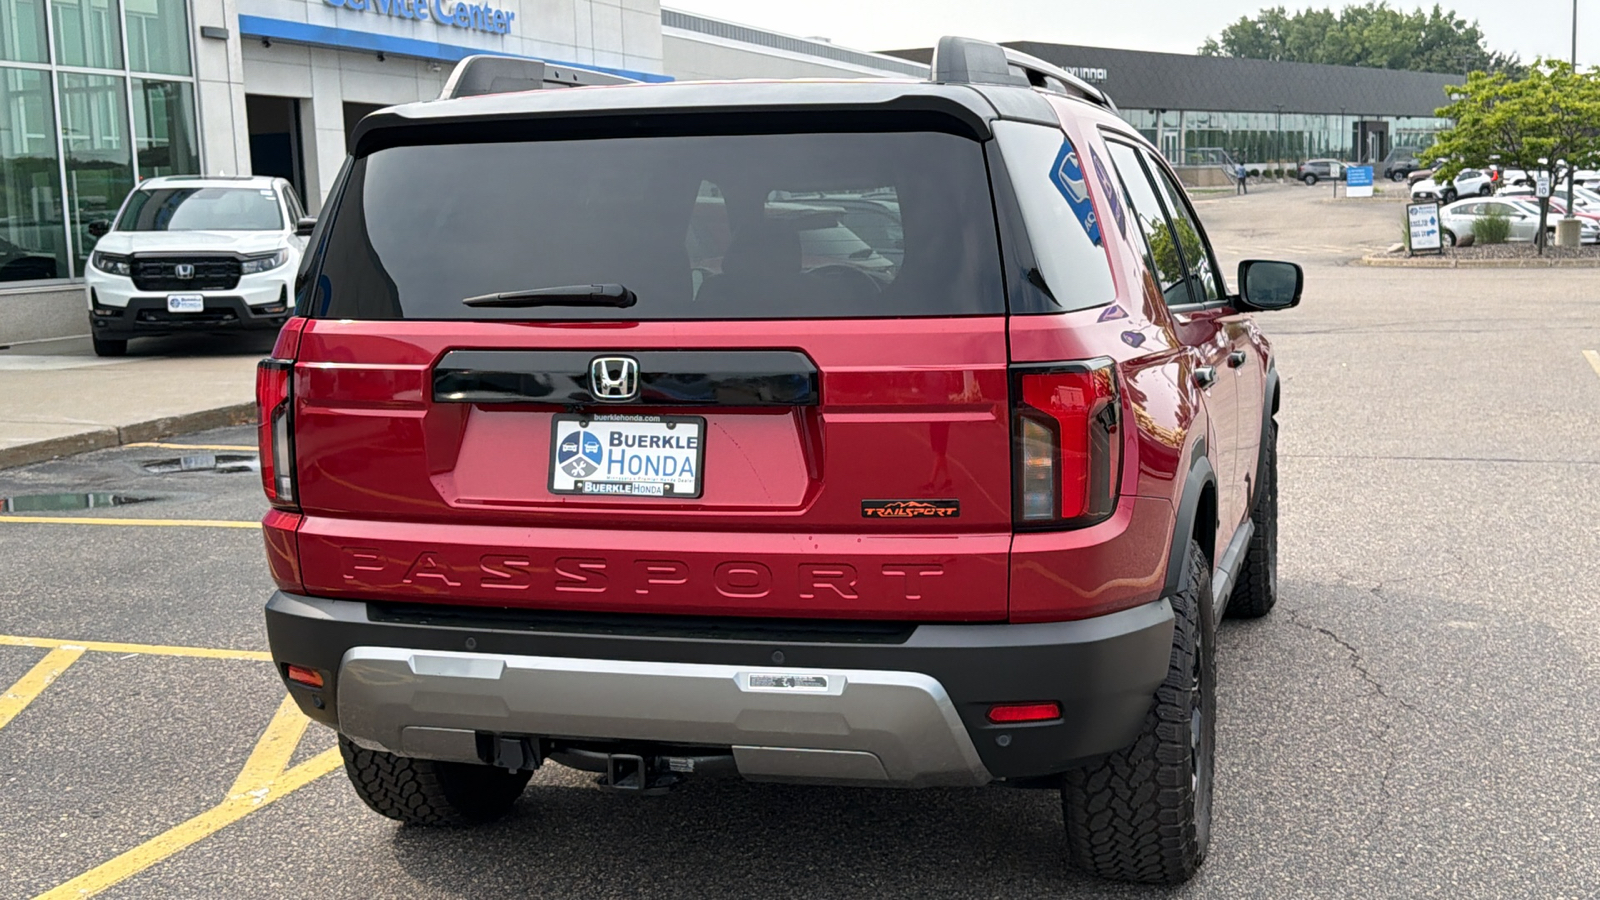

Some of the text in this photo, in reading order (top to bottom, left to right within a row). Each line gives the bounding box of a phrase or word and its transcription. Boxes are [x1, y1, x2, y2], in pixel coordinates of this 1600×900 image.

[323, 0, 515, 34] vice Center
[1061, 66, 1107, 79] YUNDAI
[1538, 187, 1547, 195] 10
[593, 414, 661, 422] buerklehonda.com
[609, 431, 698, 449] BUERKLE
[607, 448, 694, 477] HONDA
[584, 481, 662, 494] BUERKLE HONDA
[864, 507, 957, 517] TRAILSPORT
[341, 546, 944, 600] PASSPORT
